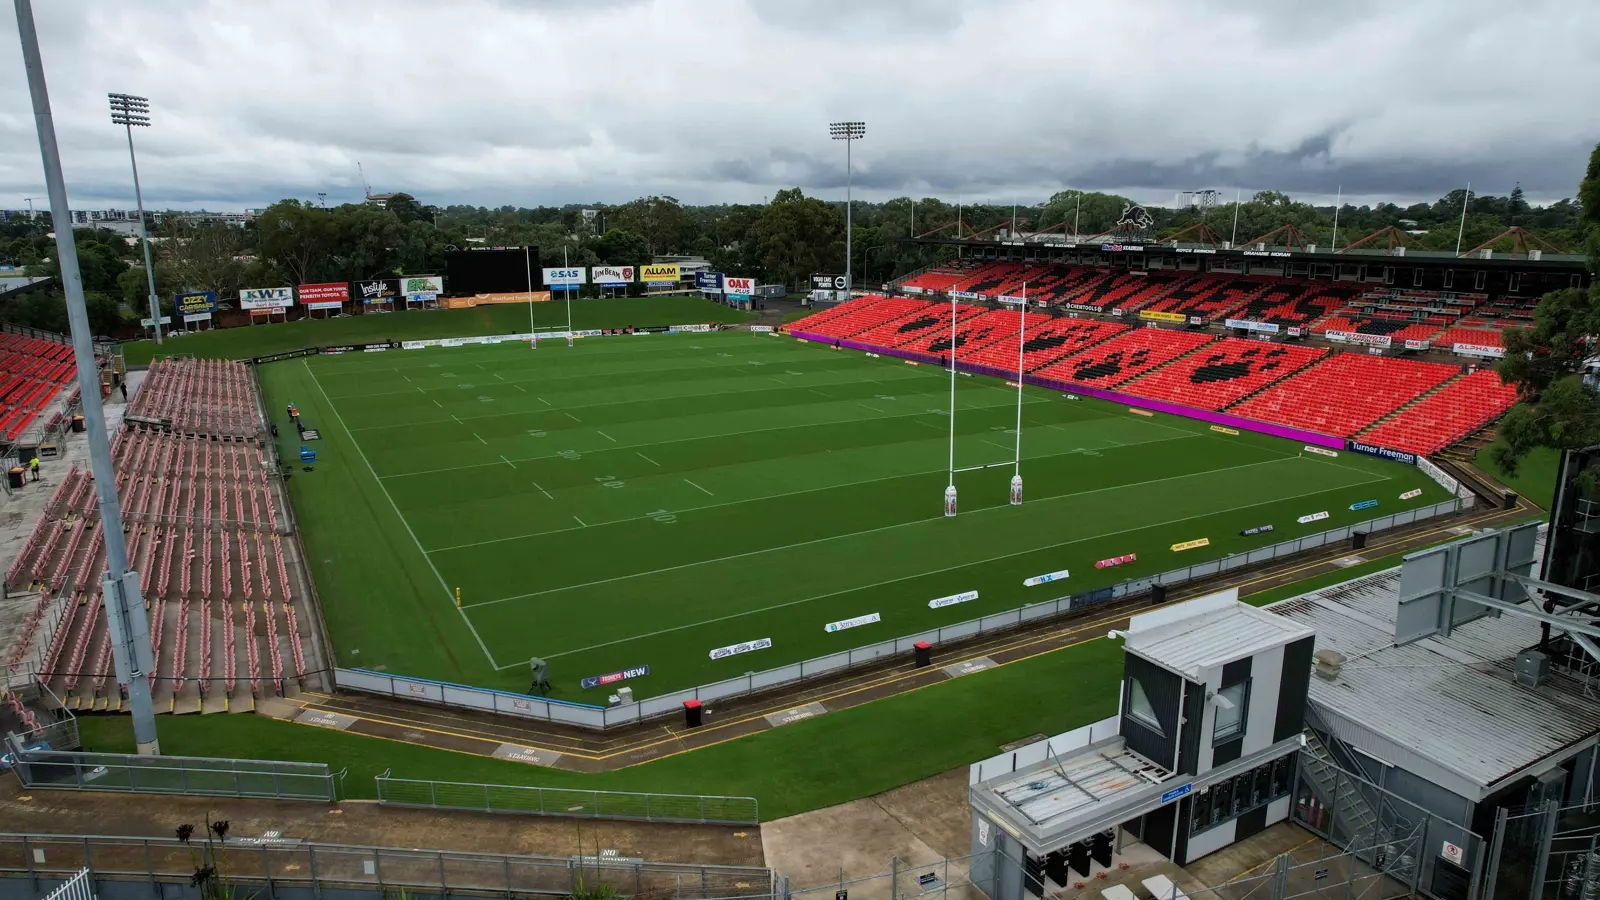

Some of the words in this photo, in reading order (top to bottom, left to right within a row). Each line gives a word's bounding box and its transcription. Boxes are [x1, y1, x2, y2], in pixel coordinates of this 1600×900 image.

[558, 270, 579, 278] SAS
[593, 270, 604, 280] JIM
[604, 268, 621, 280] BEAM
[644, 267, 676, 275] ALLAM
[360, 281, 388, 297] Instyle
[728, 279, 750, 289] OAK
[183, 295, 208, 304] OZZY
[1070, 303, 1097, 312] CHEMTOOLS
[1352, 441, 1378, 453] Turner
[1379, 447, 1414, 461] Freeman
[623, 667, 646, 679] NEW
[507, 752, 541, 763] STANDING
[264, 830, 279, 838] NO
